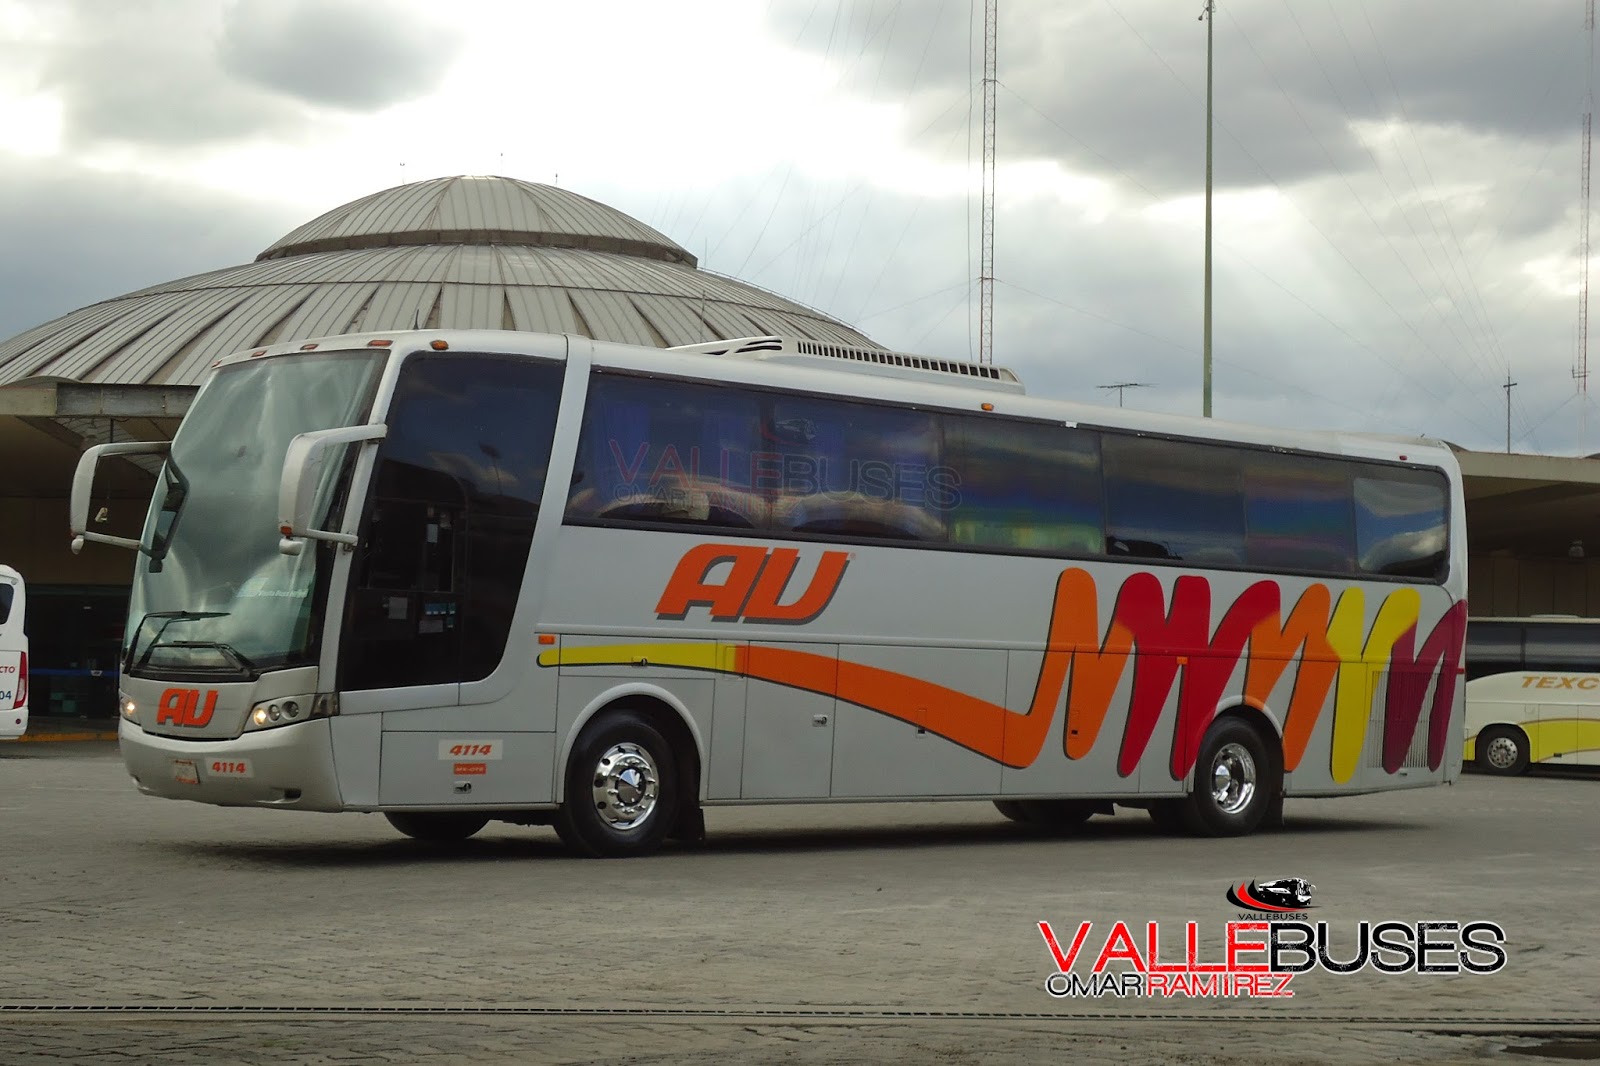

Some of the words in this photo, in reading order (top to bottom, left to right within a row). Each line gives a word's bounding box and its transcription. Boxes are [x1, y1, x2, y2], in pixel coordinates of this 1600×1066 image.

[654, 543, 850, 626] AU
[156, 687, 219, 729] AU
[449, 744, 492, 756] 4114
[212, 761, 246, 774] 4114
